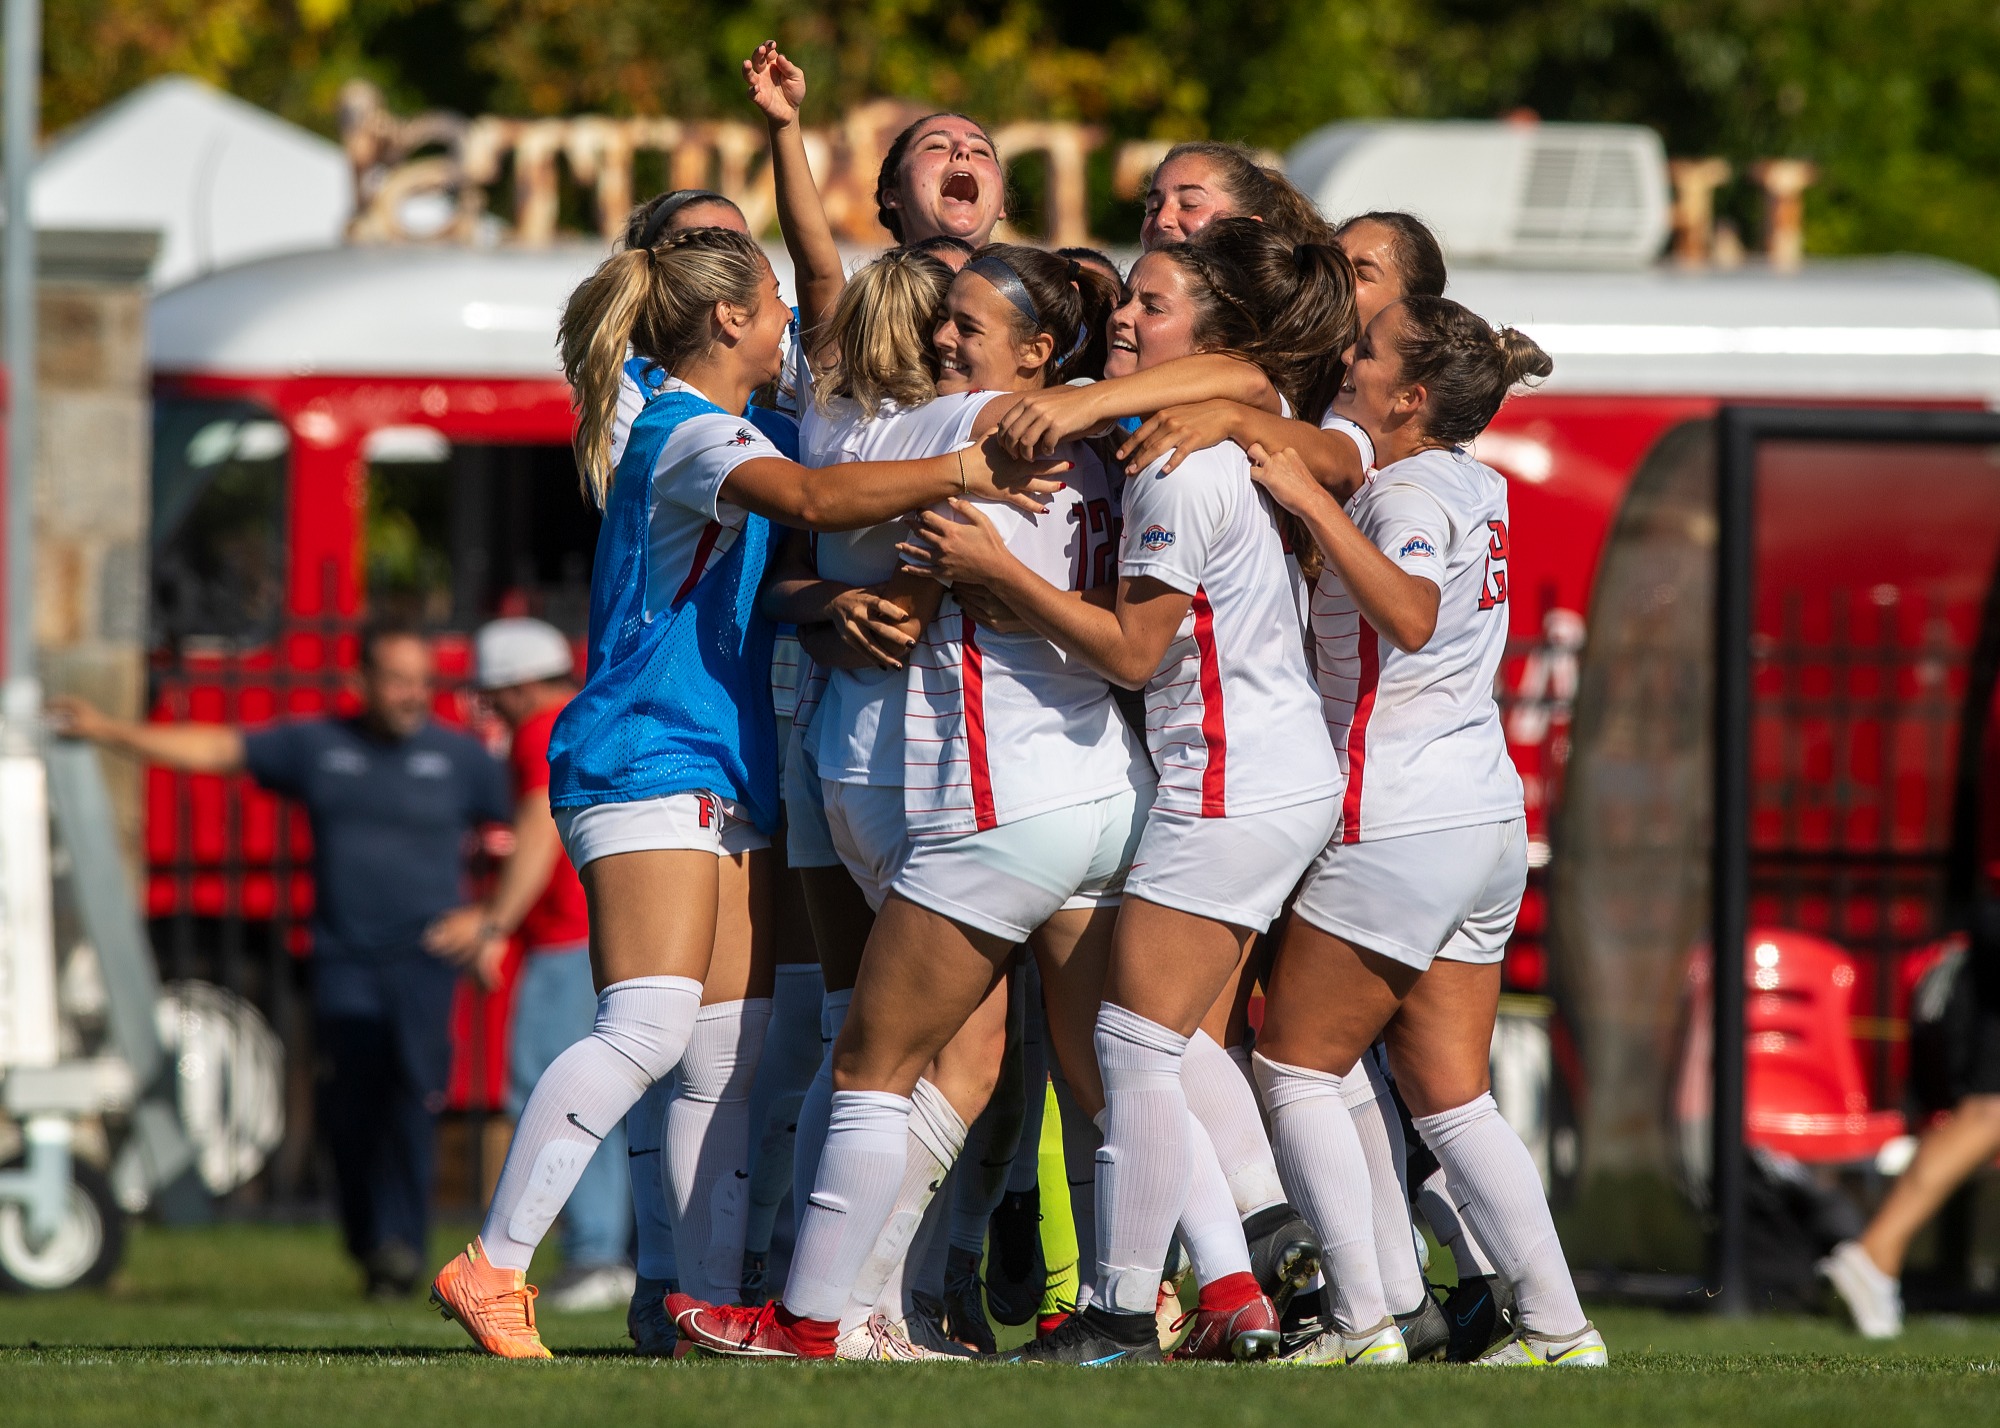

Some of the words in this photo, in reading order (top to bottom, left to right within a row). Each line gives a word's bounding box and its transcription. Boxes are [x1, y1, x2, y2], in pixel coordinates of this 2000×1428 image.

[1071, 497, 1114, 591] 12
[1141, 531, 1175, 549] MAAC
[1399, 538, 1438, 559] MAAC
[697, 796, 715, 828] F
